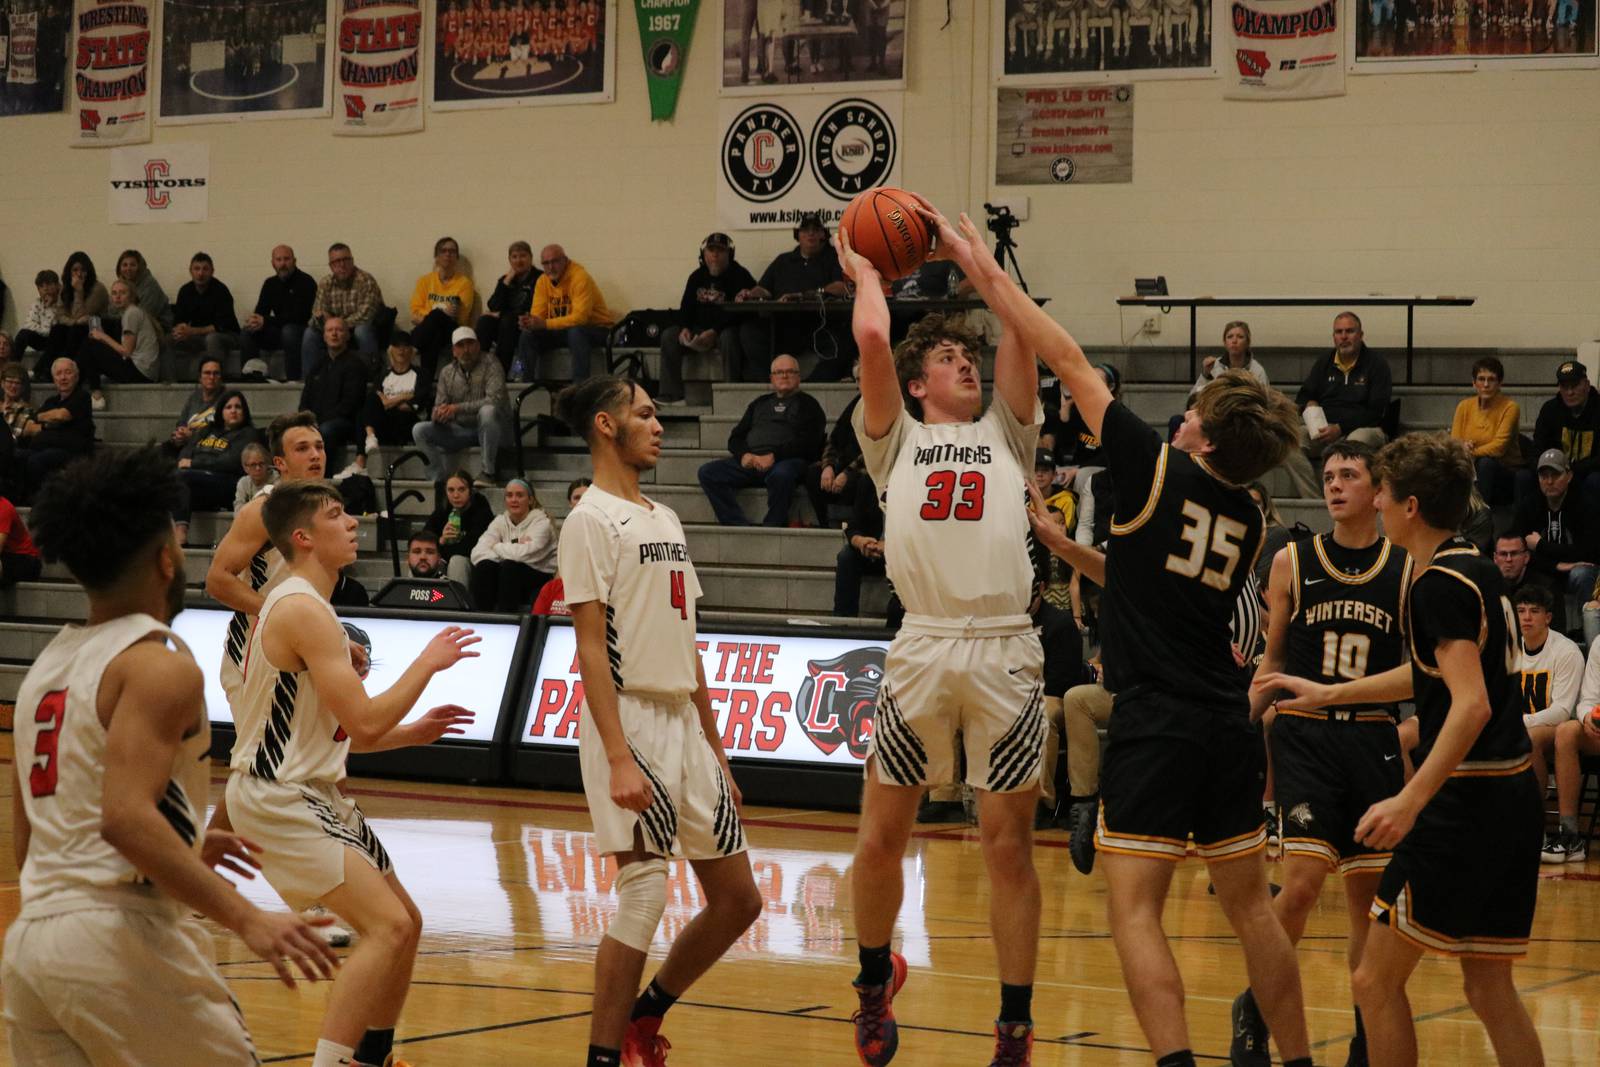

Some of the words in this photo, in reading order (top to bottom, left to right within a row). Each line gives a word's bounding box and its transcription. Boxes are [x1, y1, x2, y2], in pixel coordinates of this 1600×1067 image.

[79, 5, 149, 32] WRESTLING
[338, 12, 422, 53] STATE
[649, 14, 681, 31] 1967
[1232, 0, 1337, 38] CHAMPION
[76, 31, 151, 70] STATE
[76, 65, 148, 101] CHAMPION
[731, 114, 797, 158] PANTHER
[820, 122, 839, 168] HIGH
[847, 111, 886, 164] SCHOOL
[110, 177, 206, 189] VISITORS
[752, 178, 774, 192] TV
[840, 176, 863, 190] TV
[914, 443, 992, 466] PANTHERS
[920, 470, 986, 521] 33
[639, 542, 689, 564] PANTHER
[1165, 498, 1249, 592] 35
[409, 588, 430, 601] POSS
[670, 570, 688, 620] 4
[1305, 600, 1393, 634] WINTERSET
[715, 641, 780, 684] THE
[1321, 629, 1372, 680] 10
[530, 678, 793, 752] PAERS
